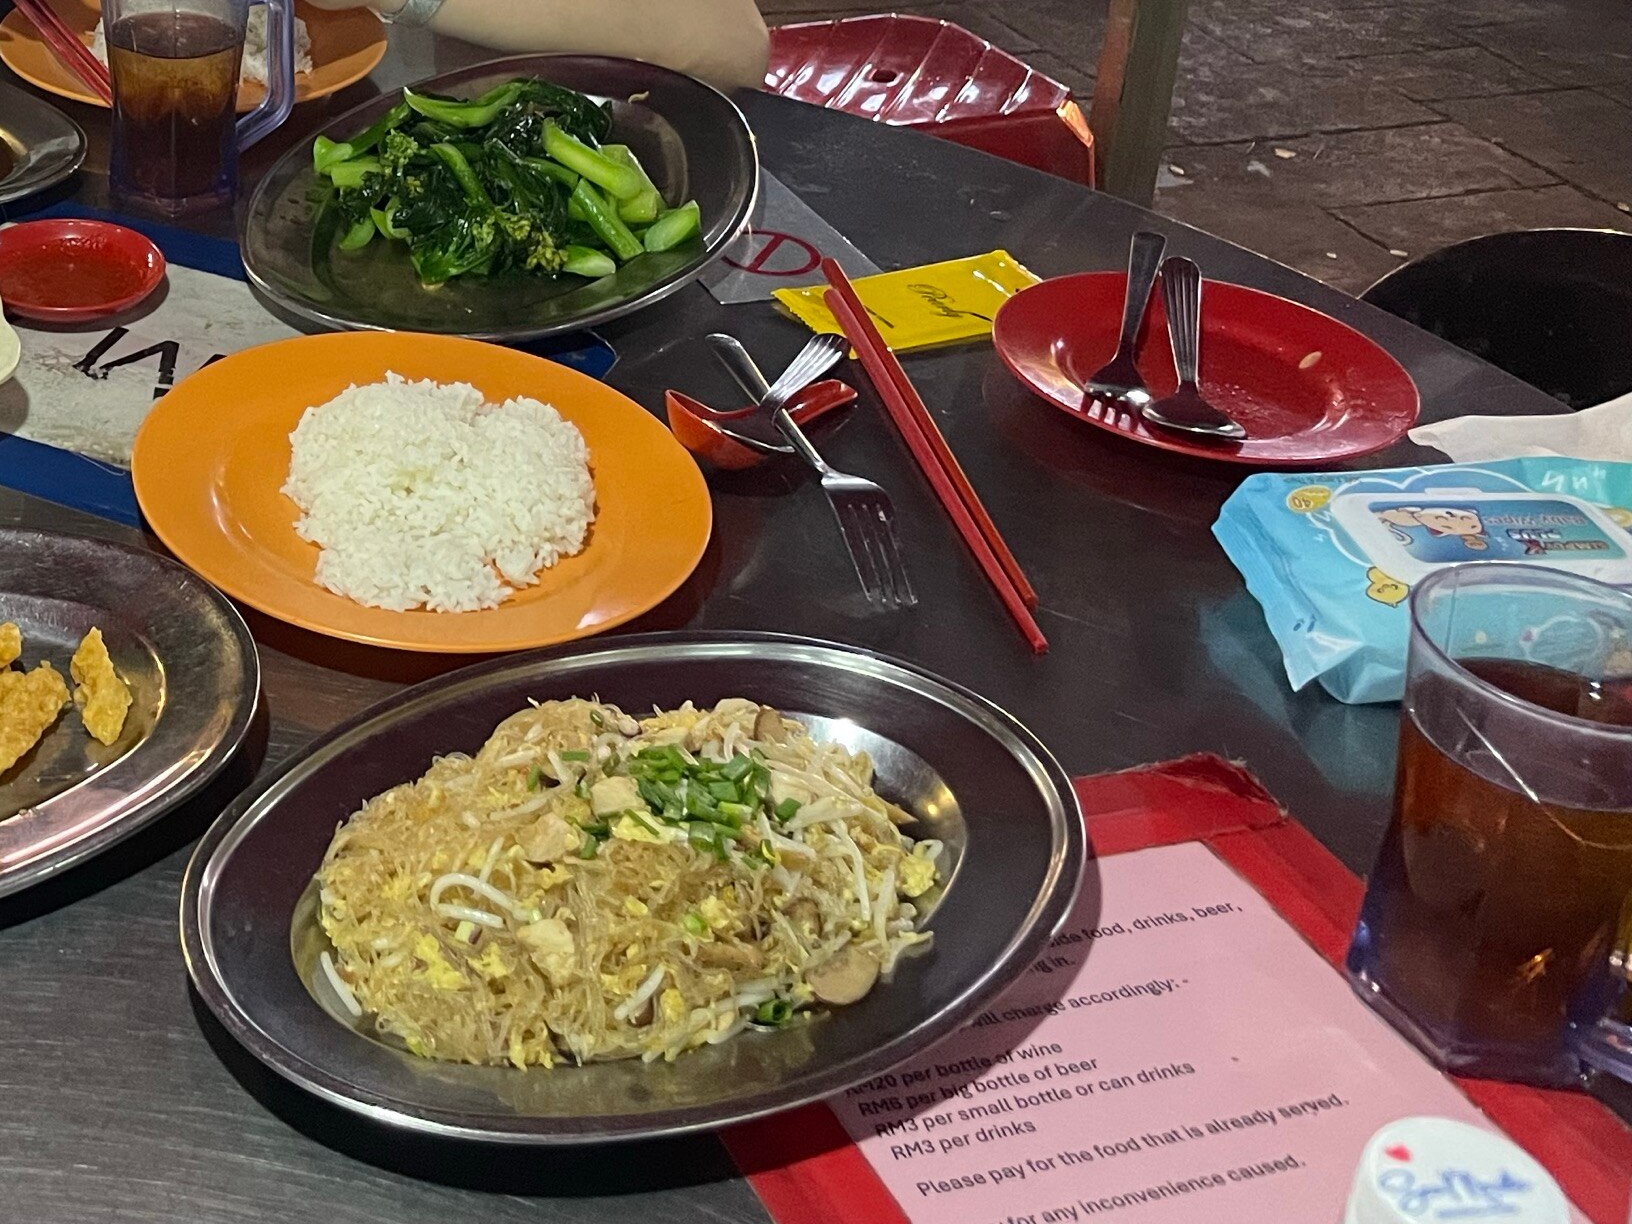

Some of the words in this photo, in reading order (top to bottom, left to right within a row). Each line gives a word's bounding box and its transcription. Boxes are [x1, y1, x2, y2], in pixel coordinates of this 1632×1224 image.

[1083, 922, 1133, 941] food,
[1133, 911, 1195, 931] drinks,
[1194, 901, 1244, 919] beer,
[1003, 999, 1067, 1022] charge
[1067, 976, 1180, 1010] accordingly:
[858, 1099, 903, 1117] RM6
[905, 1091, 937, 1111] per
[940, 1082, 973, 1101] big
[972, 1069, 1031, 1093] bottle
[1033, 1064, 1053, 1082] of
[1055, 1057, 1098, 1077] beer
[901, 1067, 933, 1088] per
[935, 1054, 993, 1077] bottle
[994, 1048, 1014, 1066] of
[1016, 1040, 1063, 1061] wine
[874, 1116, 919, 1139] RM3
[921, 1111, 953, 1132] per
[957, 1097, 1013, 1123] small
[1014, 1084, 1073, 1110] bottle
[1074, 1082, 1095, 1098] or
[1097, 1074, 1135, 1093] can
[1136, 1060, 1196, 1085] drinks
[890, 1139, 936, 1161] RM3
[938, 1133, 970, 1155] per
[974, 1120, 1037, 1144] drinks
[915, 1173, 987, 1197] Please
[987, 1163, 1027, 1185] pay
[1025, 1155, 1057, 1174] for
[1057, 1149, 1094, 1168] the
[1092, 1137, 1142, 1160] food
[1141, 1128, 1184, 1149] that
[1182, 1122, 1205, 1140] is
[1204, 1108, 1279, 1136] already
[1277, 1092, 1351, 1119] served.
[1041, 1202, 1080, 1223] any
[1078, 1173, 1228, 1216] inconvenience
[1226, 1153, 1307, 1183] caused.
